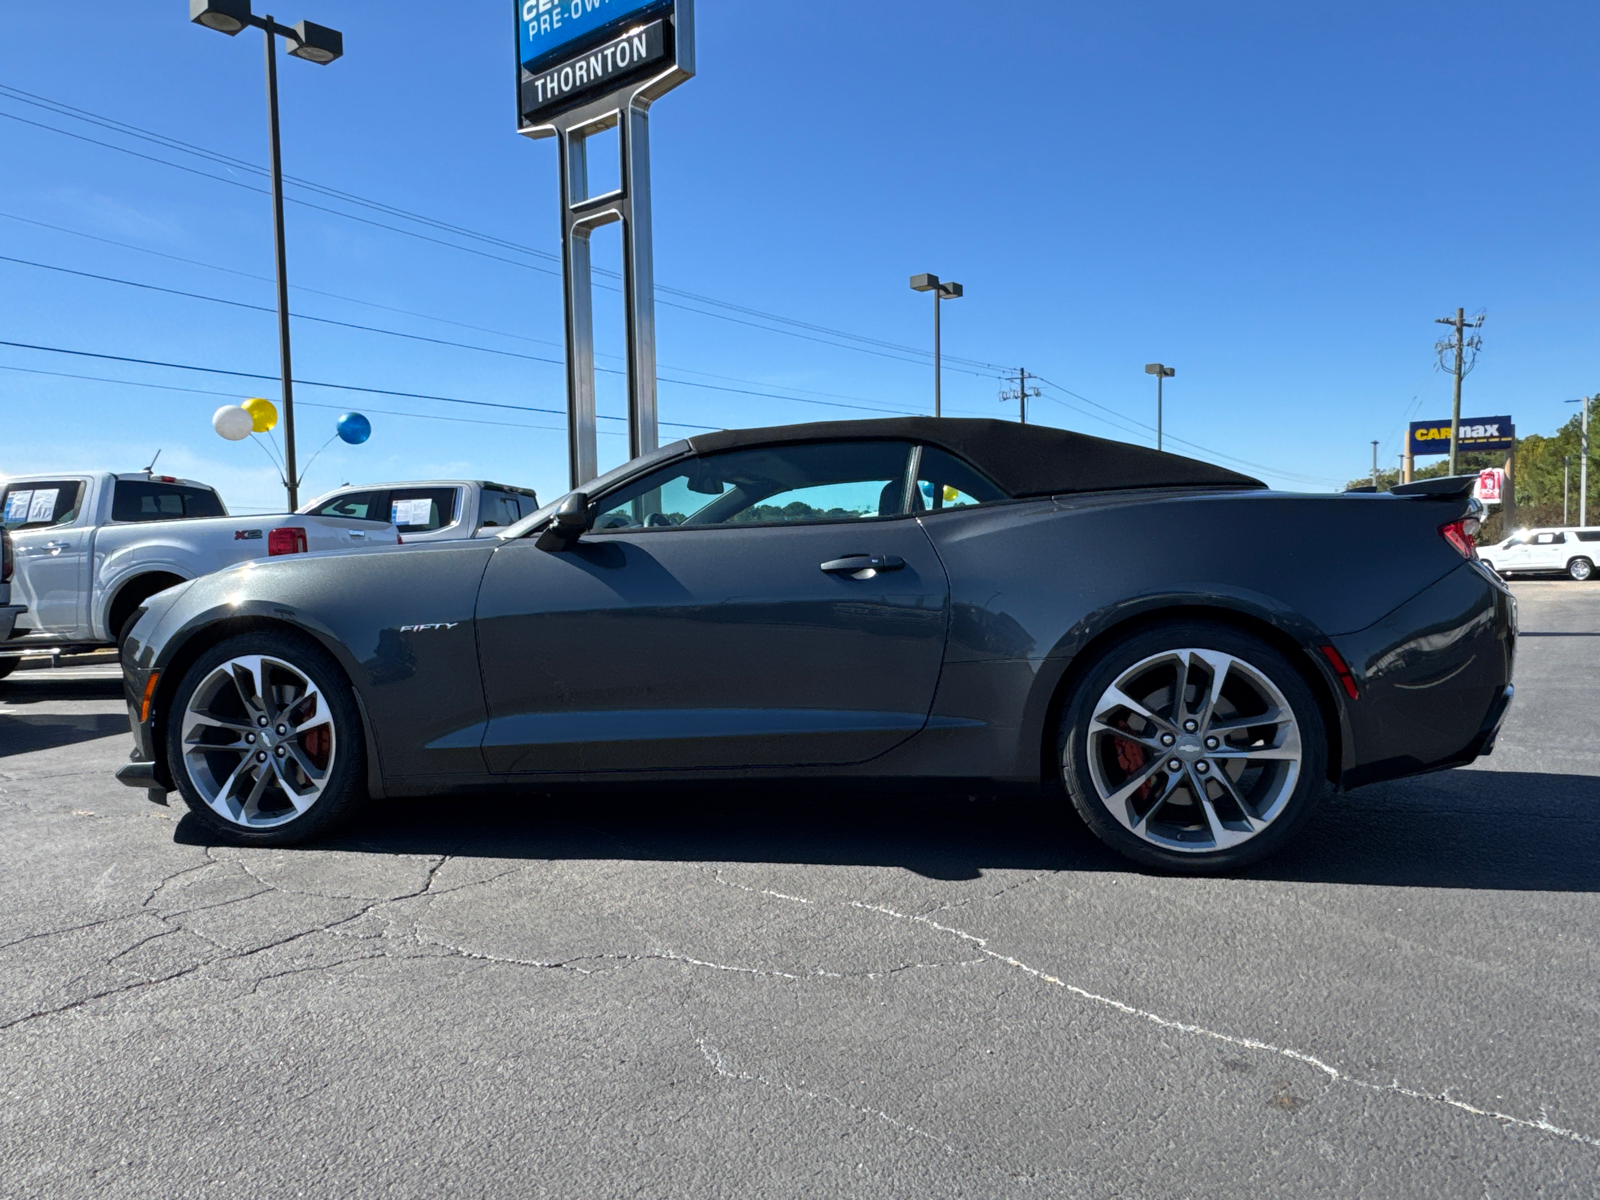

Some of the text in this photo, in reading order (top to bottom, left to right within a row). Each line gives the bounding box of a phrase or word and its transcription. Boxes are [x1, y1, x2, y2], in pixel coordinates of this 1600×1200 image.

[528, 0, 609, 42] PRE-OW
[535, 33, 648, 103] THORNTON
[400, 622, 459, 633] FIFTY
